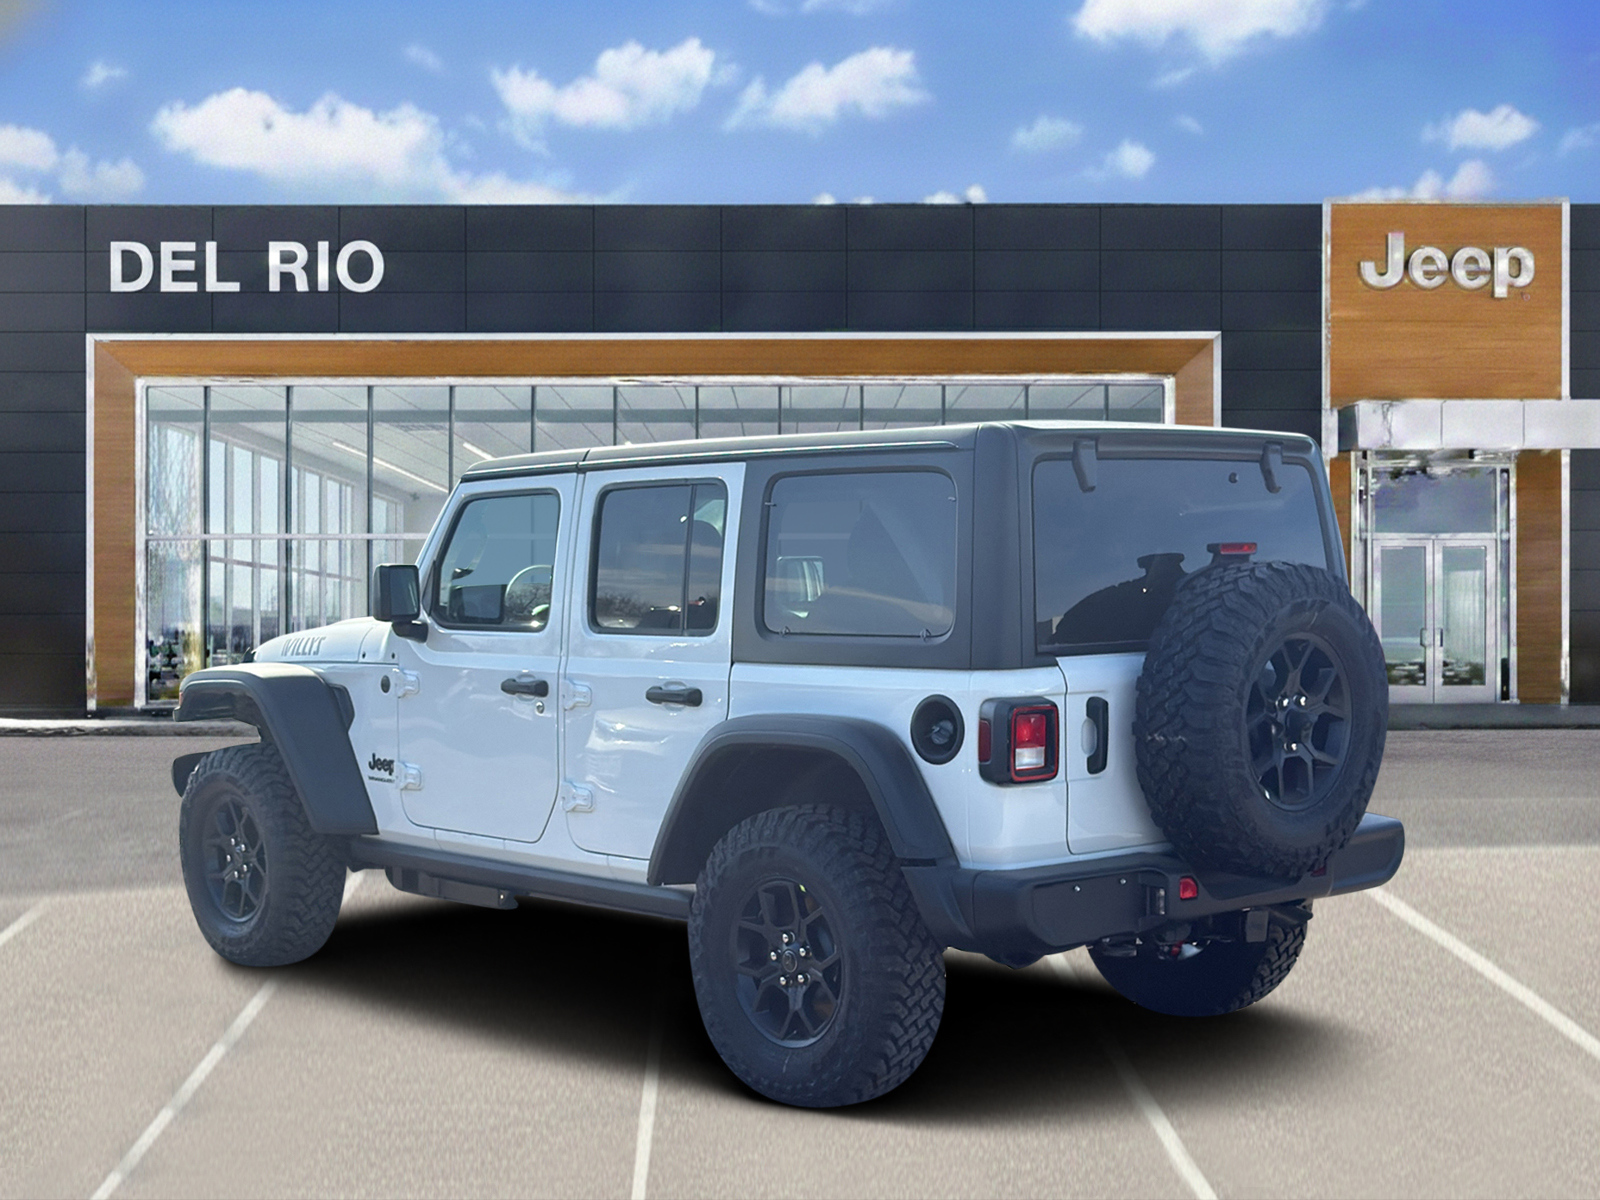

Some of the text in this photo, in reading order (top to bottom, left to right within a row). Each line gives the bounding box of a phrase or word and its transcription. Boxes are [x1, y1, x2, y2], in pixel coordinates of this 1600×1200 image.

[110, 239, 385, 293] DEL RIO
[1359, 231, 1536, 299] Jeep
[281, 636, 326, 657] WILLYS
[368, 752, 395, 776] Jeep
